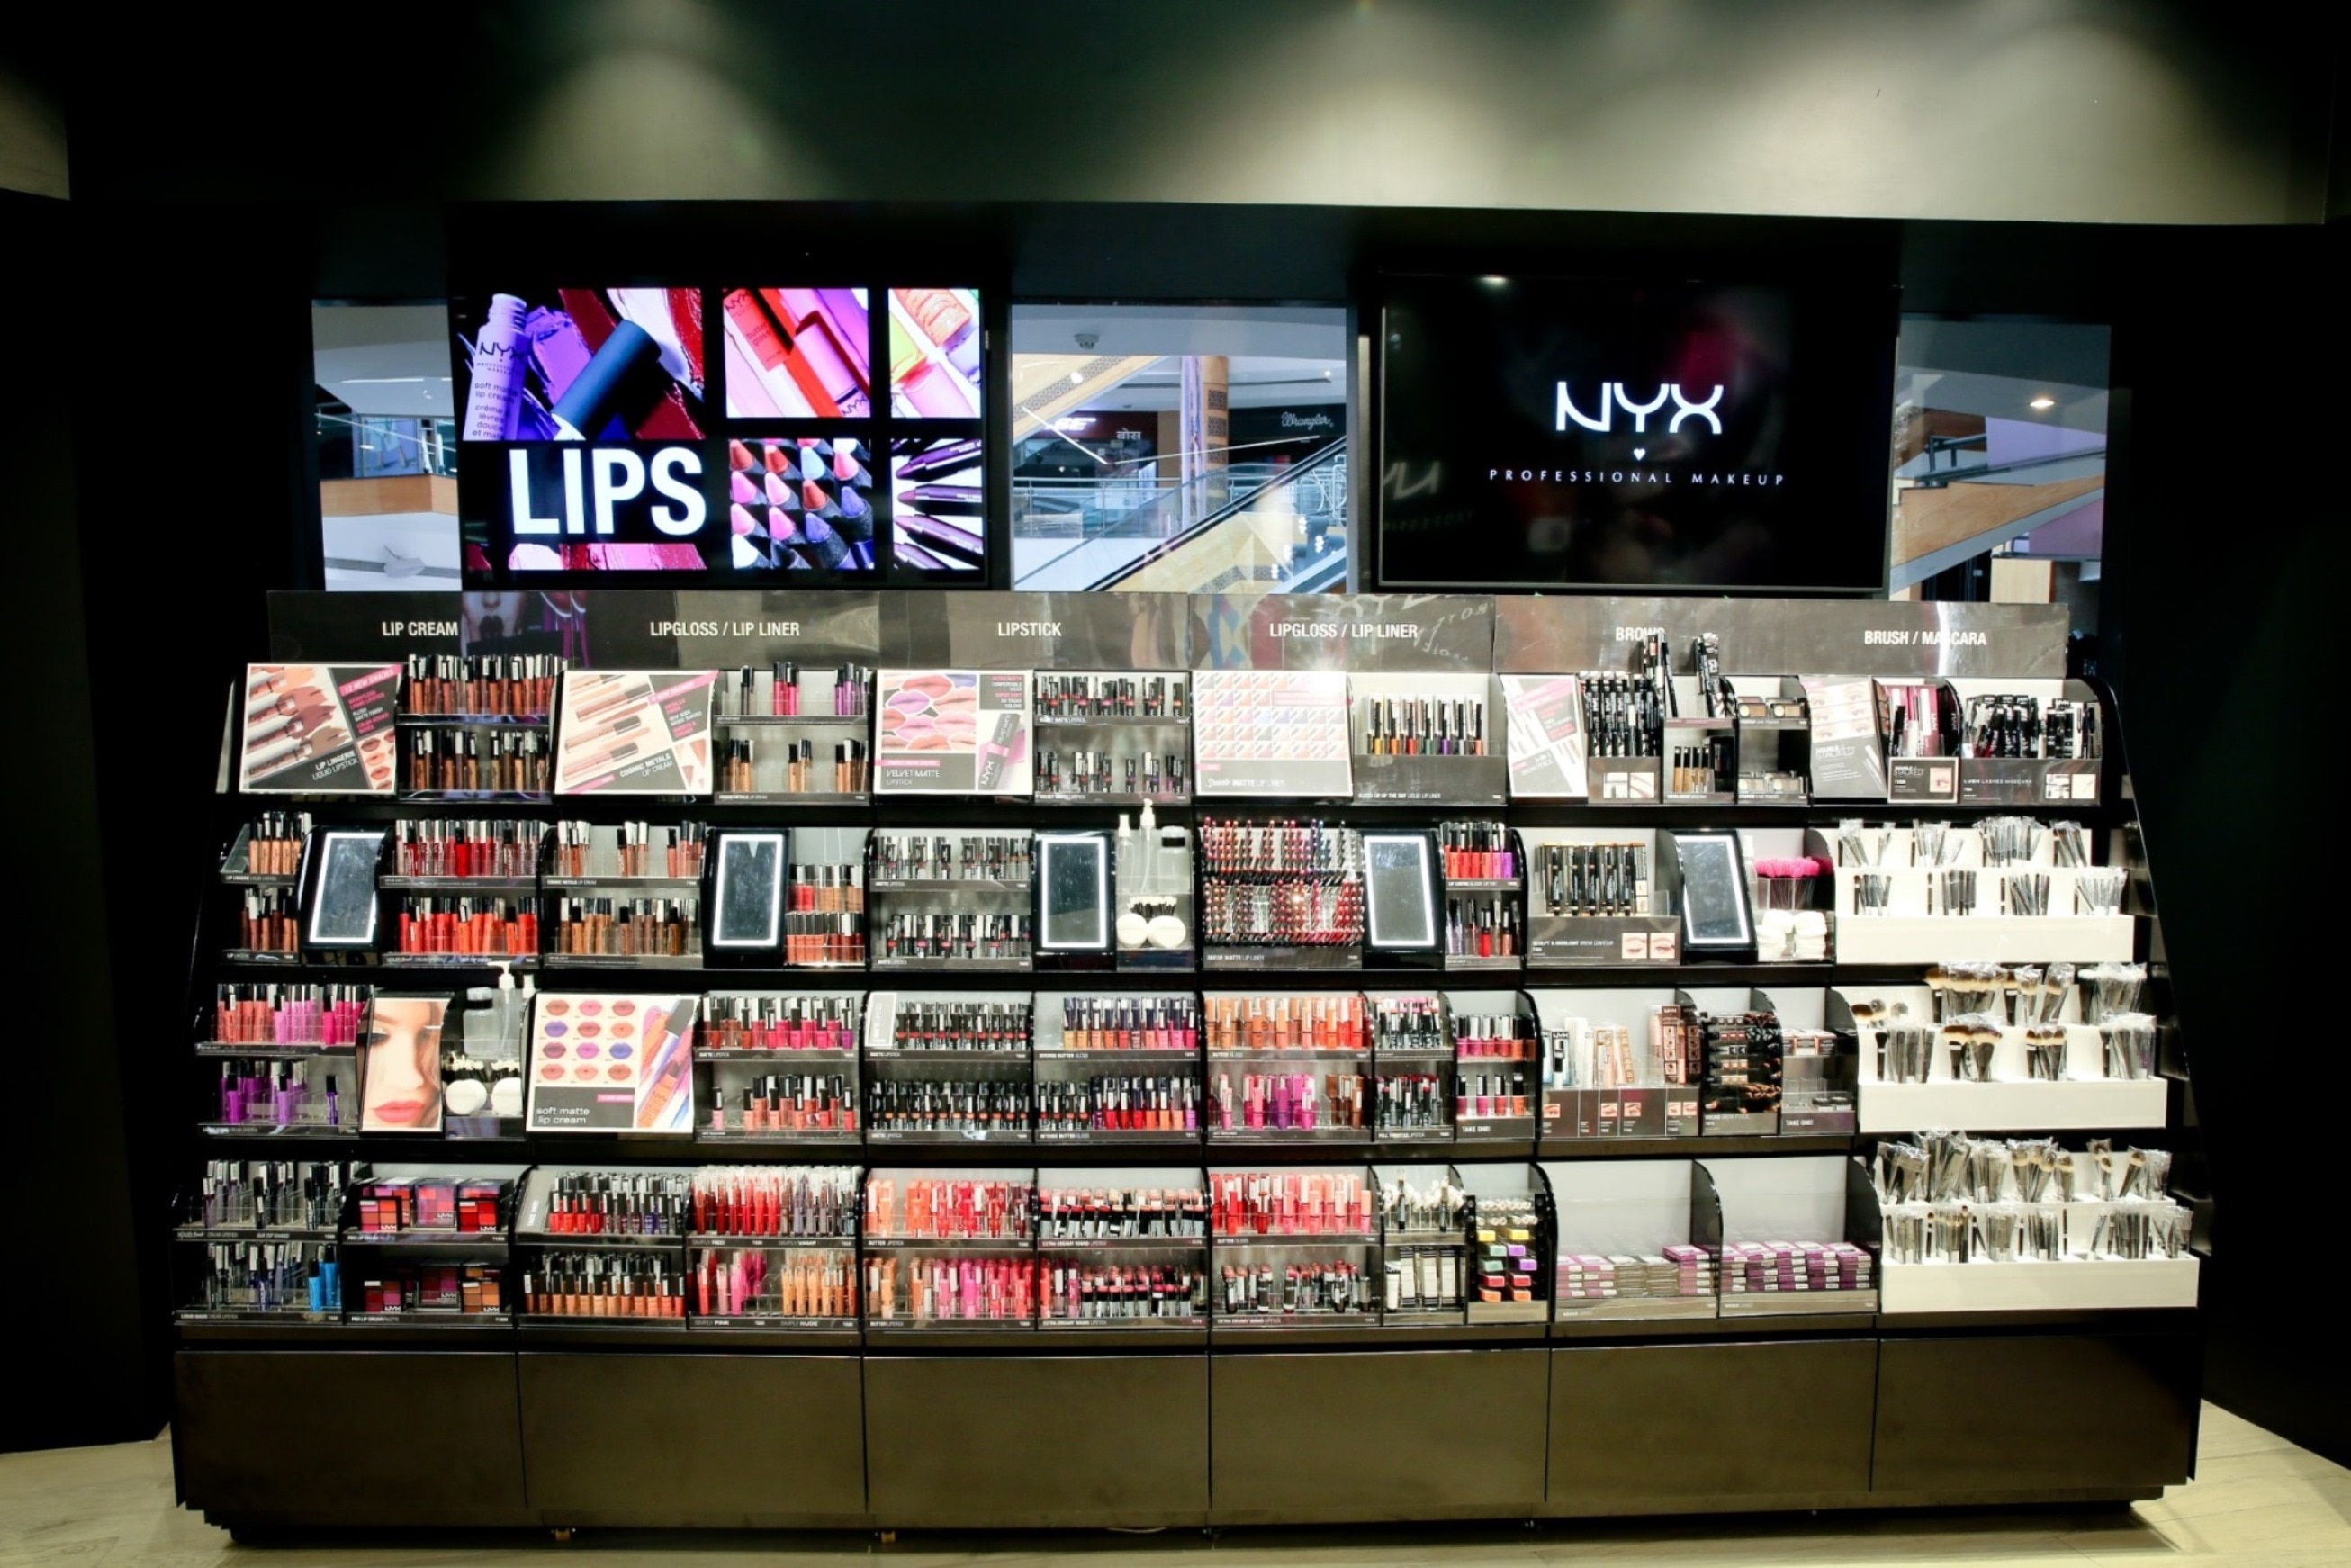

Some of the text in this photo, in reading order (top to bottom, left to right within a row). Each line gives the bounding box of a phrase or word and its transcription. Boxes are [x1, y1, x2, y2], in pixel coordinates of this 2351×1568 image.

[474, 382, 491, 390] soft
[475, 391, 486, 399] lip
[1556, 381, 1724, 435] NYX
[1282, 411, 1330, 430] Wrangler
[1116, 427, 1141, 440] बोस
[1489, 469, 1784, 486] PROFESSIONAL MAKEUP
[509, 448, 707, 536] LIPS
[382, 622, 458, 637] LIP CREAM
[650, 622, 718, 637] LIPGLOSS
[733, 622, 755, 637] LIP
[759, 622, 800, 637] LINER
[998, 622, 1062, 637] LIPSTICK
[1270, 623, 1338, 638] LIPGLOSS
[1351, 624, 1374, 638] LIP
[1377, 624, 1419, 638] LINER
[1864, 630, 1908, 644] BRUSH
[1922, 631, 1986, 646] MASCARA
[315, 749, 356, 771] LIP LINGERIE
[644, 752, 671, 768] METALS
[312, 756, 358, 781] LIQUID LIPSTICK
[887, 770, 940, 778] VELVET MATTE
[536, 1107, 590, 1115] soft matte
[538, 1116, 586, 1124] lip cream
[1786, 1119, 1799, 1127] TAKE
